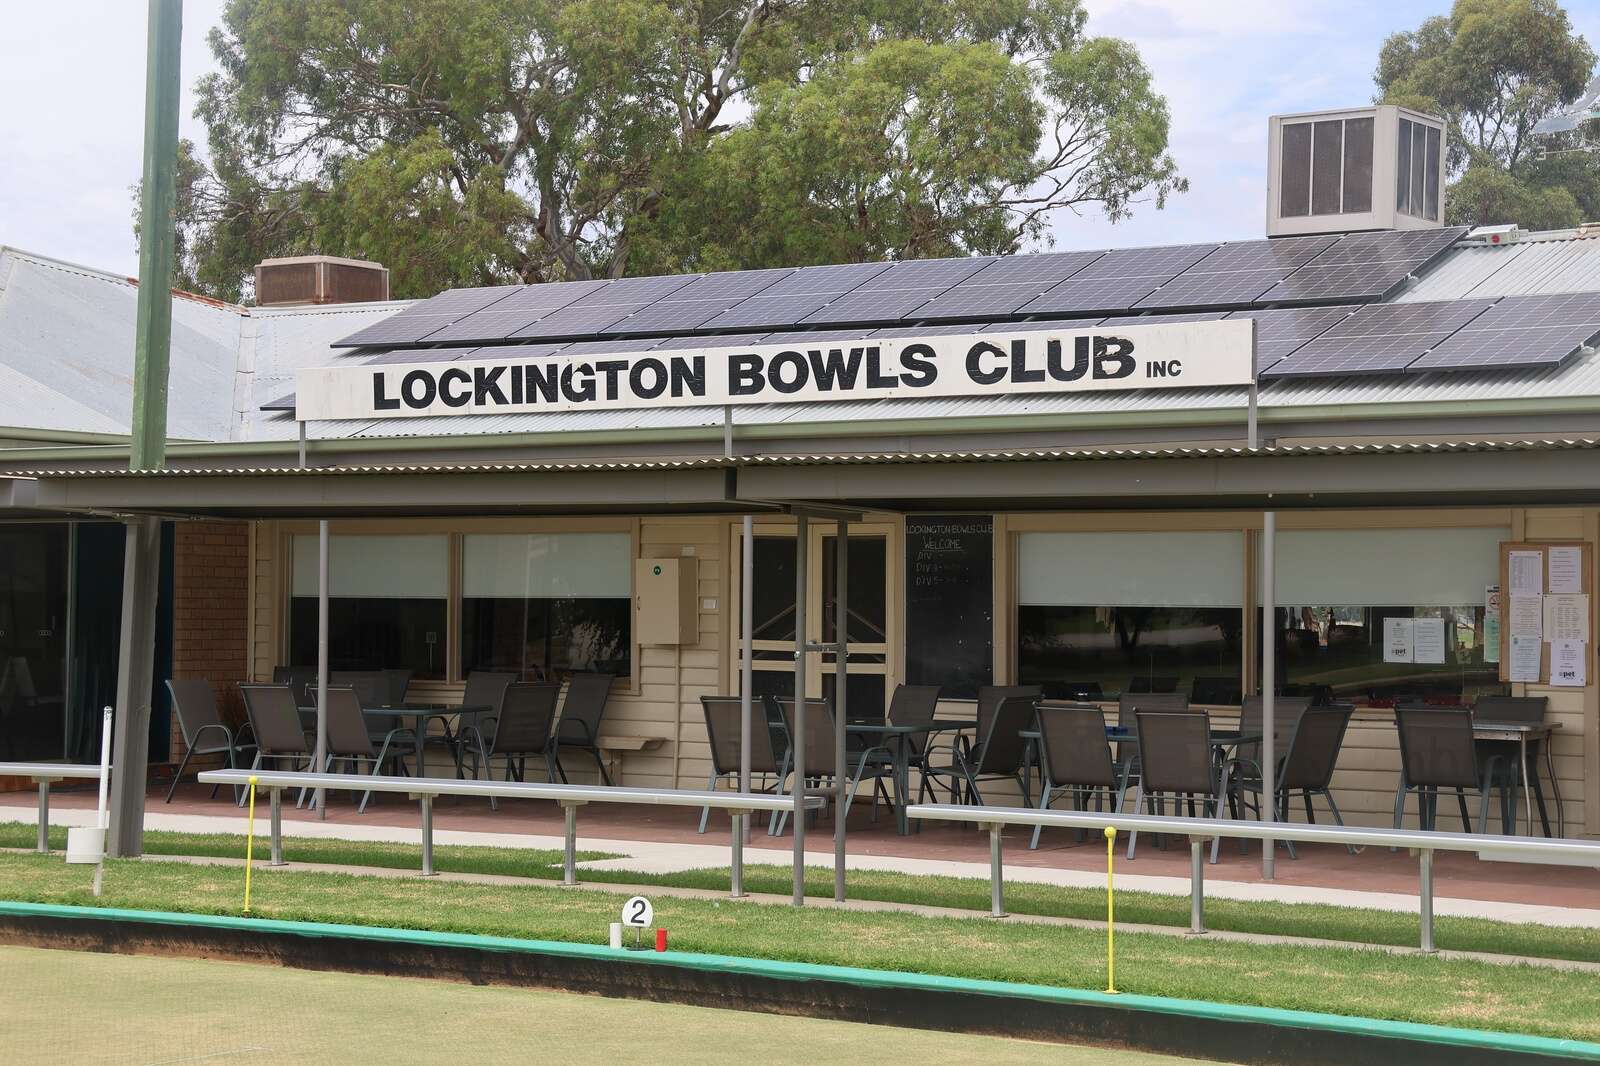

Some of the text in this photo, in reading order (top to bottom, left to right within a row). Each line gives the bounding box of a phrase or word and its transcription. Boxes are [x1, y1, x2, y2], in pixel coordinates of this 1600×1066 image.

[373, 335, 1182, 411] LOCKINGTON BOWLS CLUB INC
[906, 525, 951, 534] LOCKINGTON
[920, 536, 961, 549] WELCOME
[630, 899, 646, 924] 2
